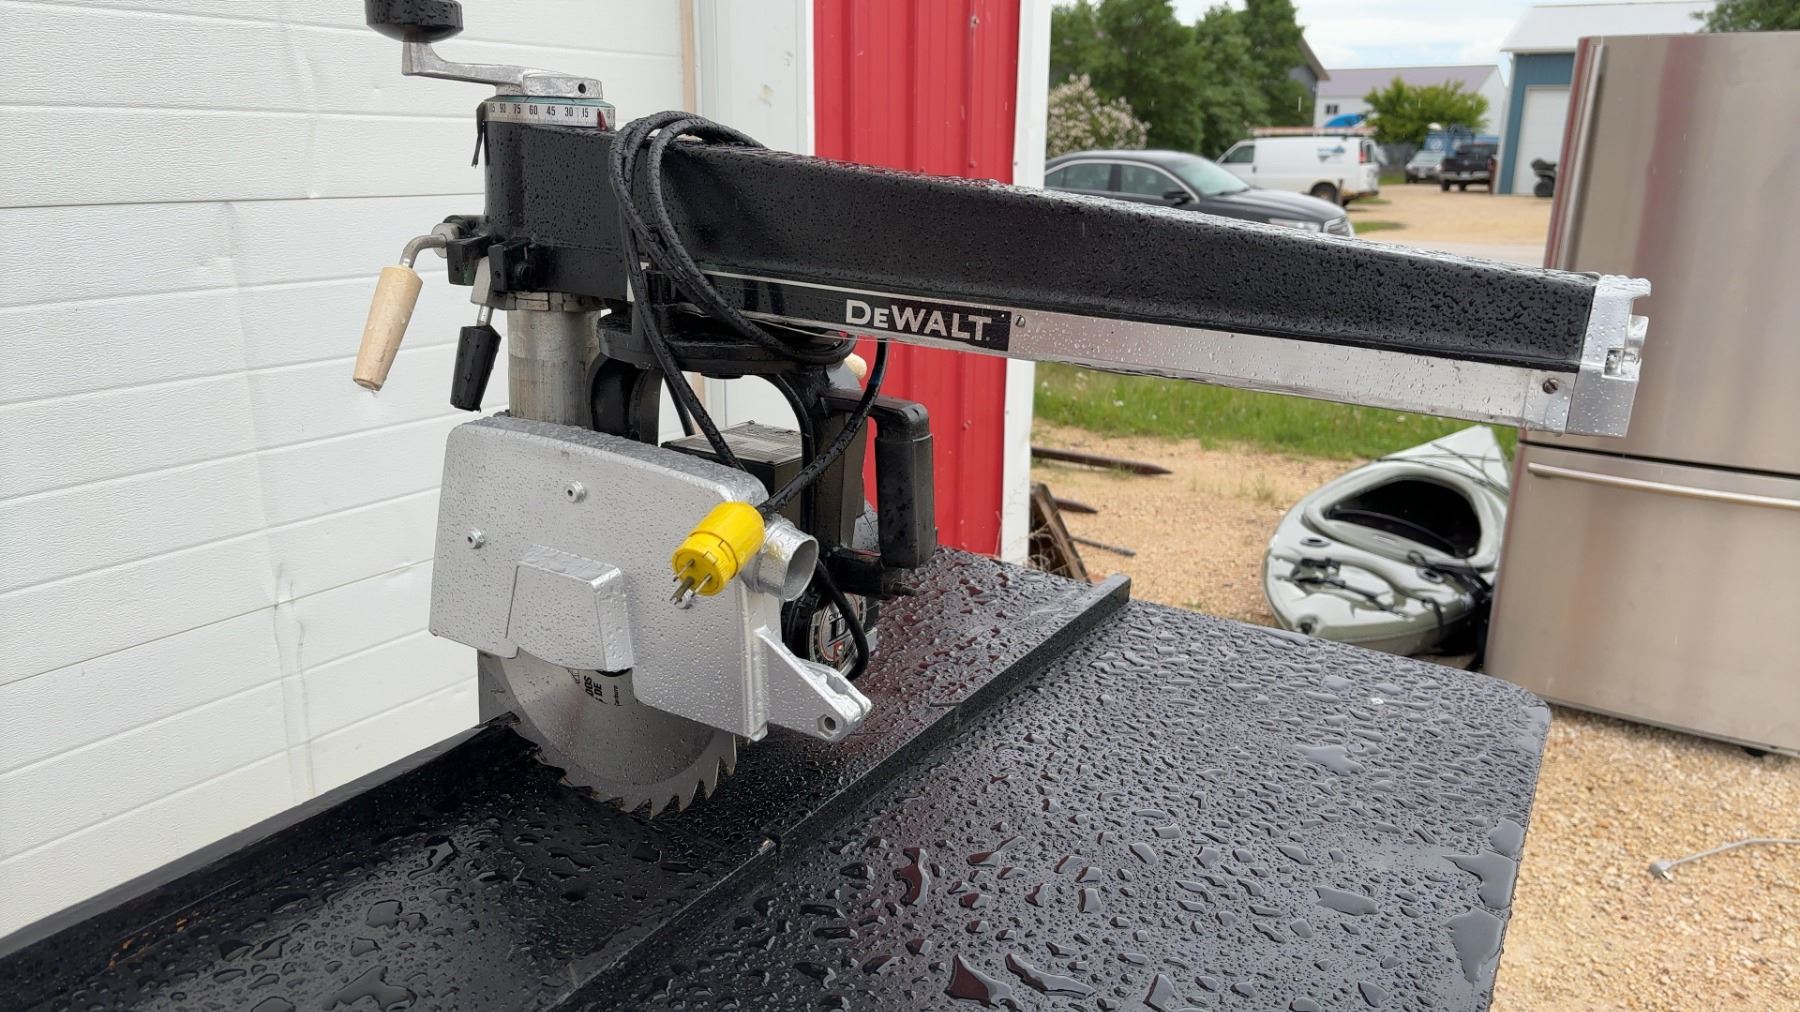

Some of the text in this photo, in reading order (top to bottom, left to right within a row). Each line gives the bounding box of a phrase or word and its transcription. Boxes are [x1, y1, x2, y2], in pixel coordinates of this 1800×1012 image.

[513, 103, 521, 114] 75
[529, 104, 538, 115] 60
[546, 105, 556, 116] 45
[564, 106, 573, 117] 30
[582, 107, 589, 118] 15
